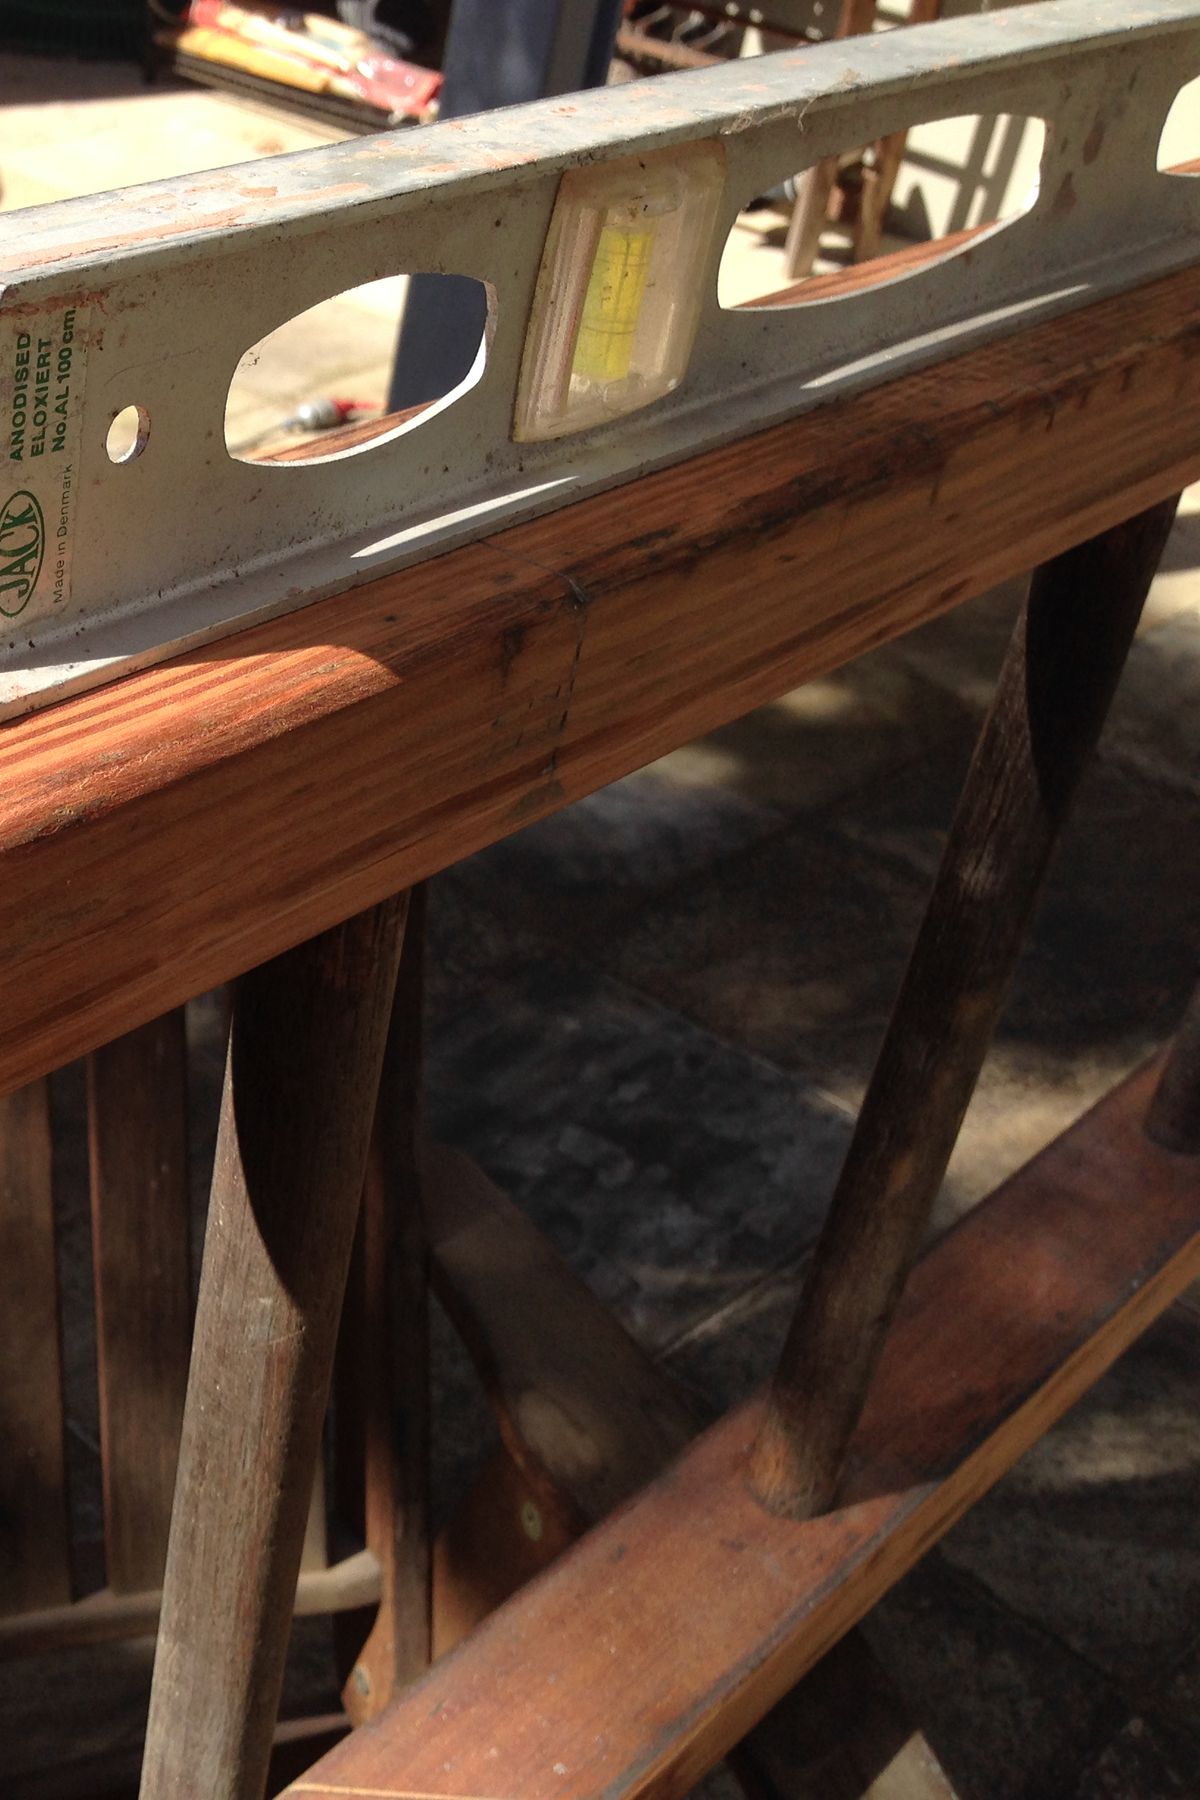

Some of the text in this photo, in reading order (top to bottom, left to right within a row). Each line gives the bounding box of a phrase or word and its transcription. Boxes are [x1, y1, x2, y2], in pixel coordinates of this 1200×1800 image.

[9, 333, 31, 462] ANODISED
[30, 338, 52, 457] ELOXIERT
[52, 463, 73, 602] Made in Denmark
